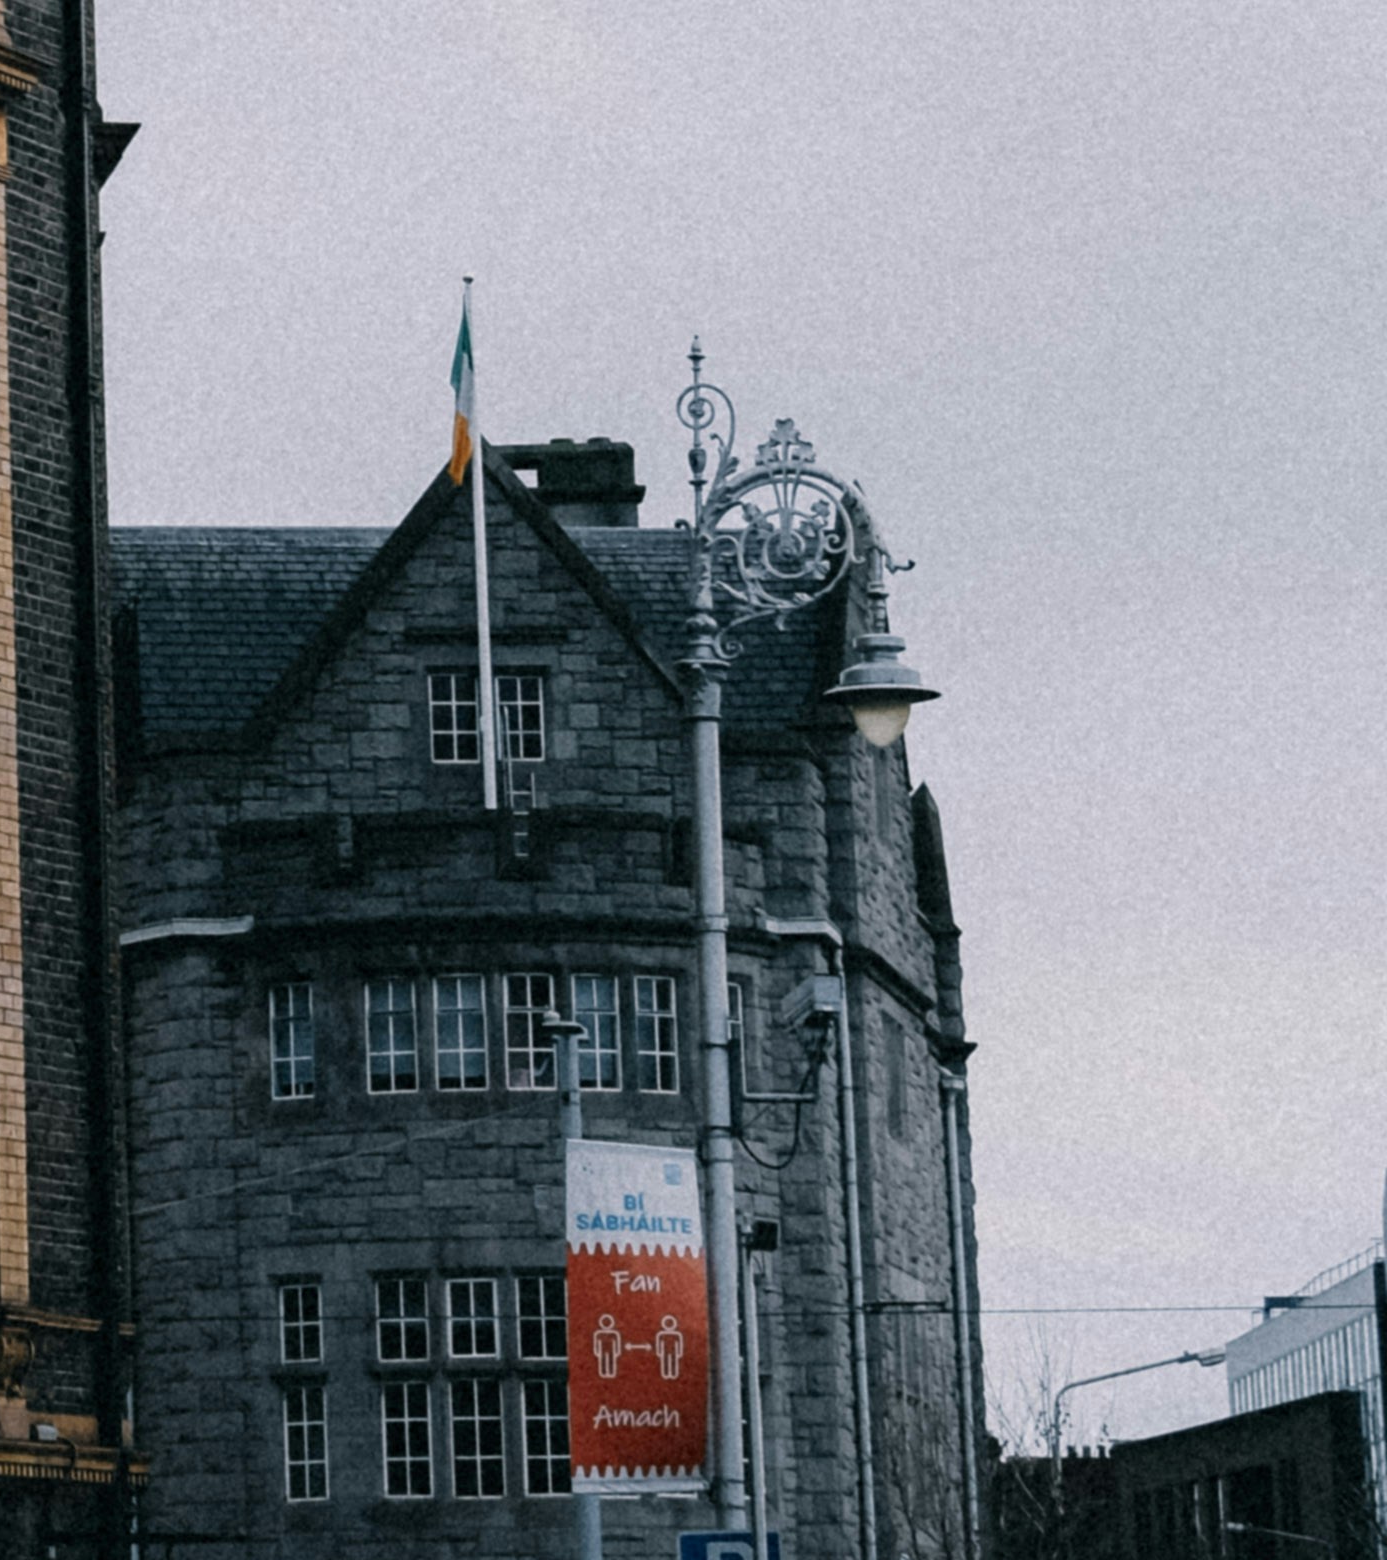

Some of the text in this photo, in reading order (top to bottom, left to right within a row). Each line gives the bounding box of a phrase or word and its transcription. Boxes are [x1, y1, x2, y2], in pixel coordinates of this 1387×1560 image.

[623, 1193, 644, 1211] BÍ
[576, 1211, 693, 1234] SÁBHÁILTE
[611, 1270, 661, 1295] Fan
[593, 1404, 680, 1429] Amach
